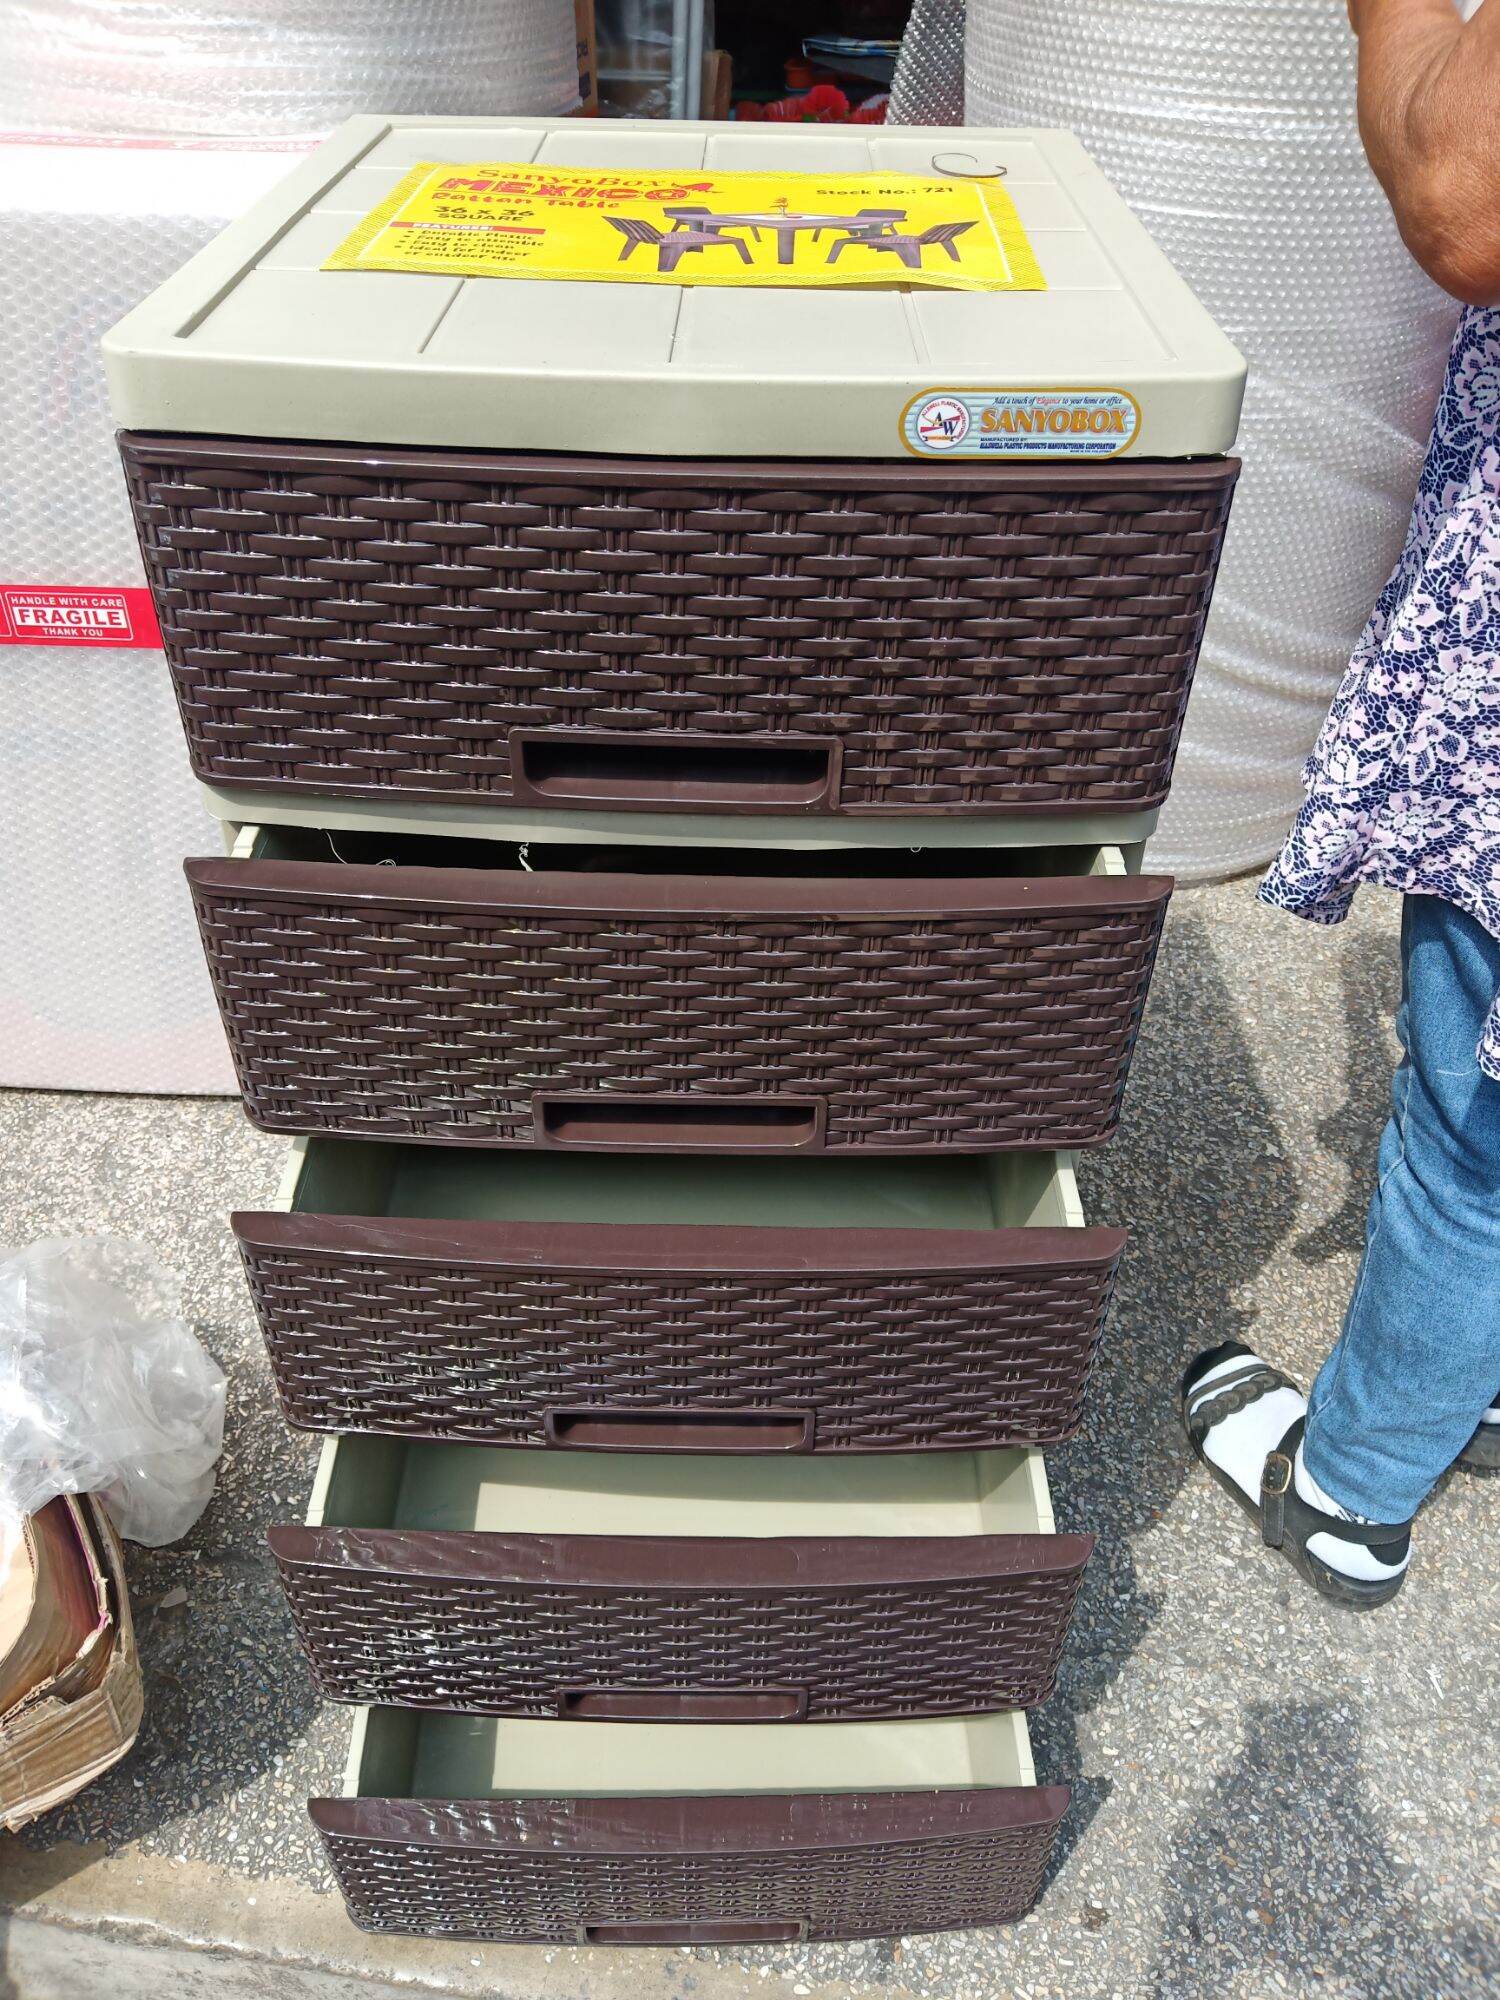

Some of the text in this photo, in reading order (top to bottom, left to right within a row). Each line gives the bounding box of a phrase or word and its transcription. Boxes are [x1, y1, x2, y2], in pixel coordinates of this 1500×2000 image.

[477, 169, 666, 187] SanyoBox
[437, 178, 688, 200] MEXICO
[432, 192, 620, 209] Rattan Table
[433, 205, 468, 214] 36
[501, 209, 535, 217] 36
[437, 213, 525, 222] SQUARE
[416, 234, 452, 242] Easy
[421, 229, 534, 240] Durable Plastic
[412, 239, 448, 247] Easy
[993, 396, 1007, 406] Add
[979, 408, 1129, 433] SANYOBOX
[1085, 442, 1117, 450] CORPORATION
[11, 596, 123, 608] HANDLE WITH CARE
[18, 608, 123, 626] FRAGILE
[42, 627, 104, 637] THANK YOU
